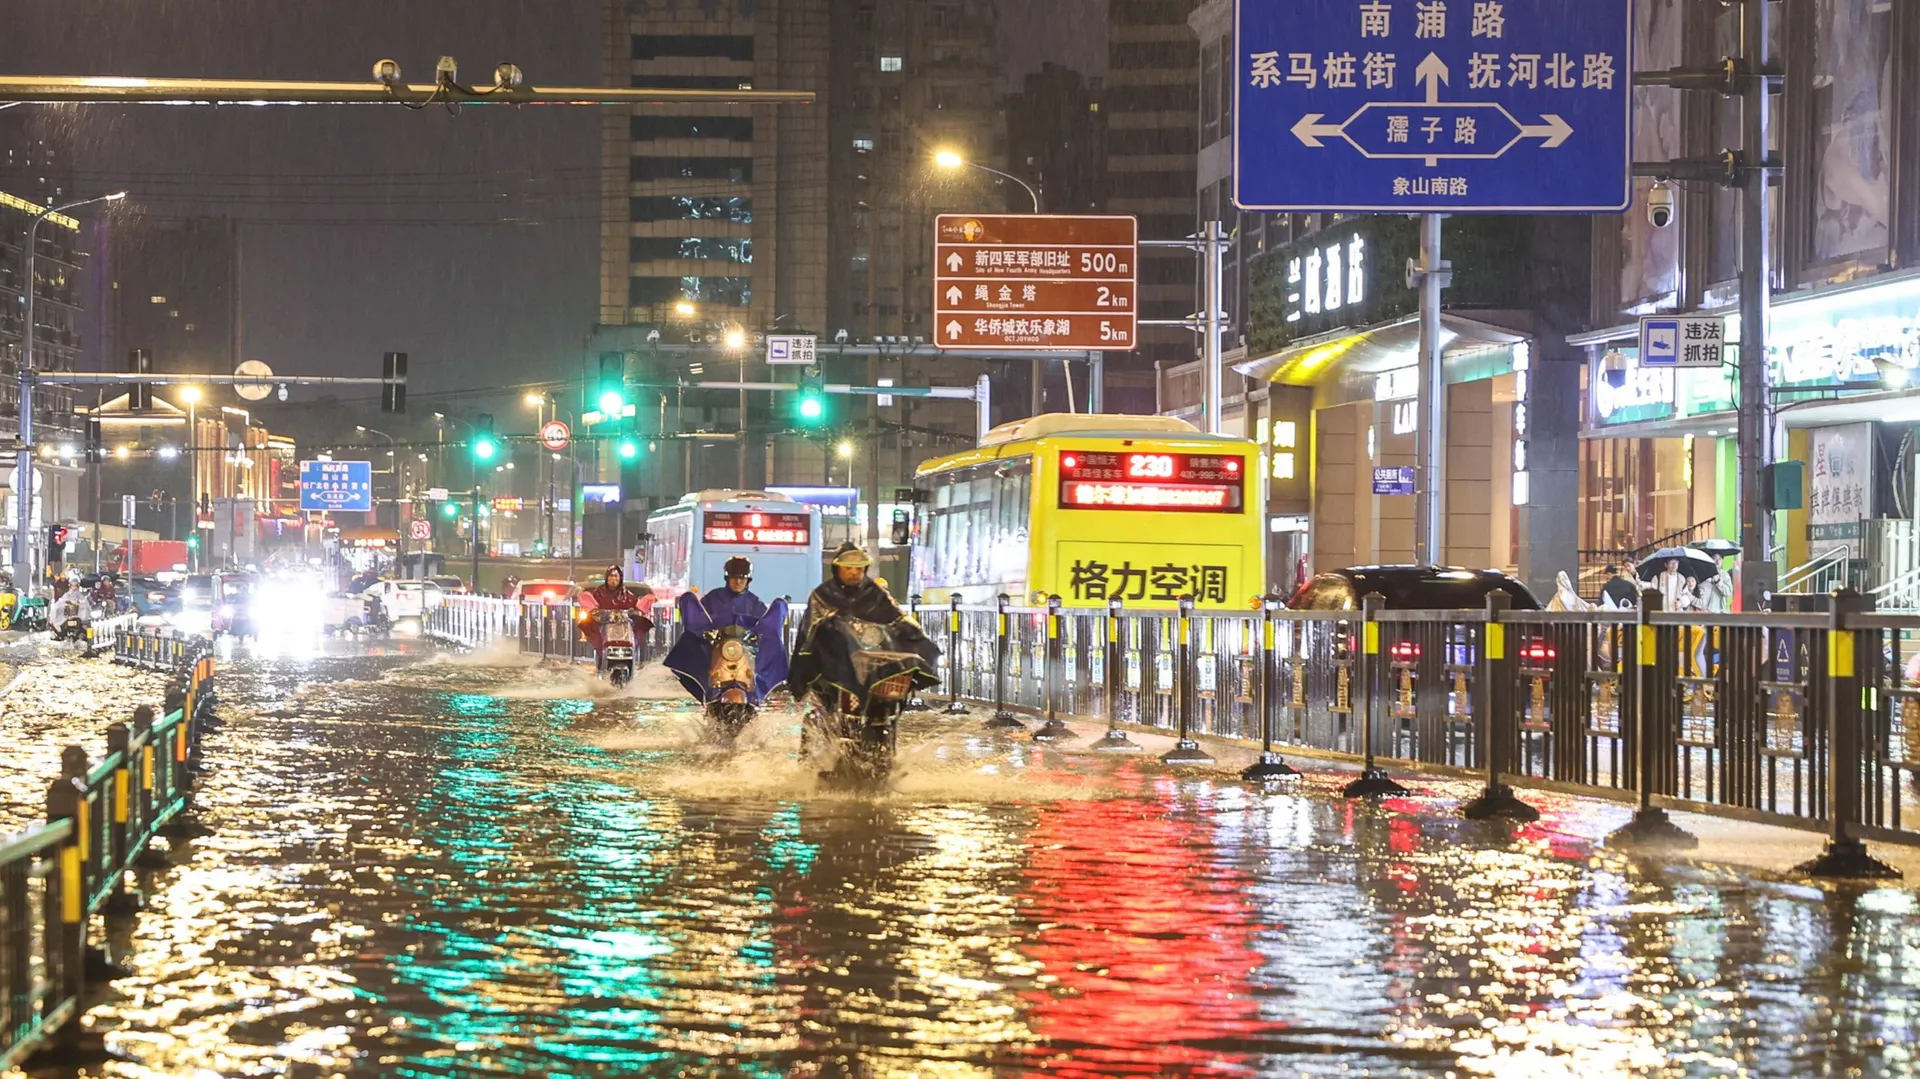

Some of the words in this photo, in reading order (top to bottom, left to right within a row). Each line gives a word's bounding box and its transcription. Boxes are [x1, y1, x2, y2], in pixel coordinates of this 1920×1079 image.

[1360, 1, 1506, 39] 南浦路
[1250, 51, 1397, 90] 系马桩街
[1468, 52, 1616, 90] 抚河北路
[1387, 115, 1477, 145] 孺子路
[1393, 177, 1468, 196] 象山南路
[975, 250, 1071, 267] 新四军军部旧址
[975, 284, 1037, 301] 绳金塔
[974, 318, 1070, 335] 华侨城欢乐象湖
[1685, 322, 1720, 340] 违法
[791, 339, 813, 348] 违法
[791, 350, 813, 360] 抓拍
[1684, 344, 1719, 362] 抓拍
[1130, 454, 1173, 477] 230
[1374, 469, 1398, 480] 公共厕所
[1070, 560, 1227, 604] 格力空调
